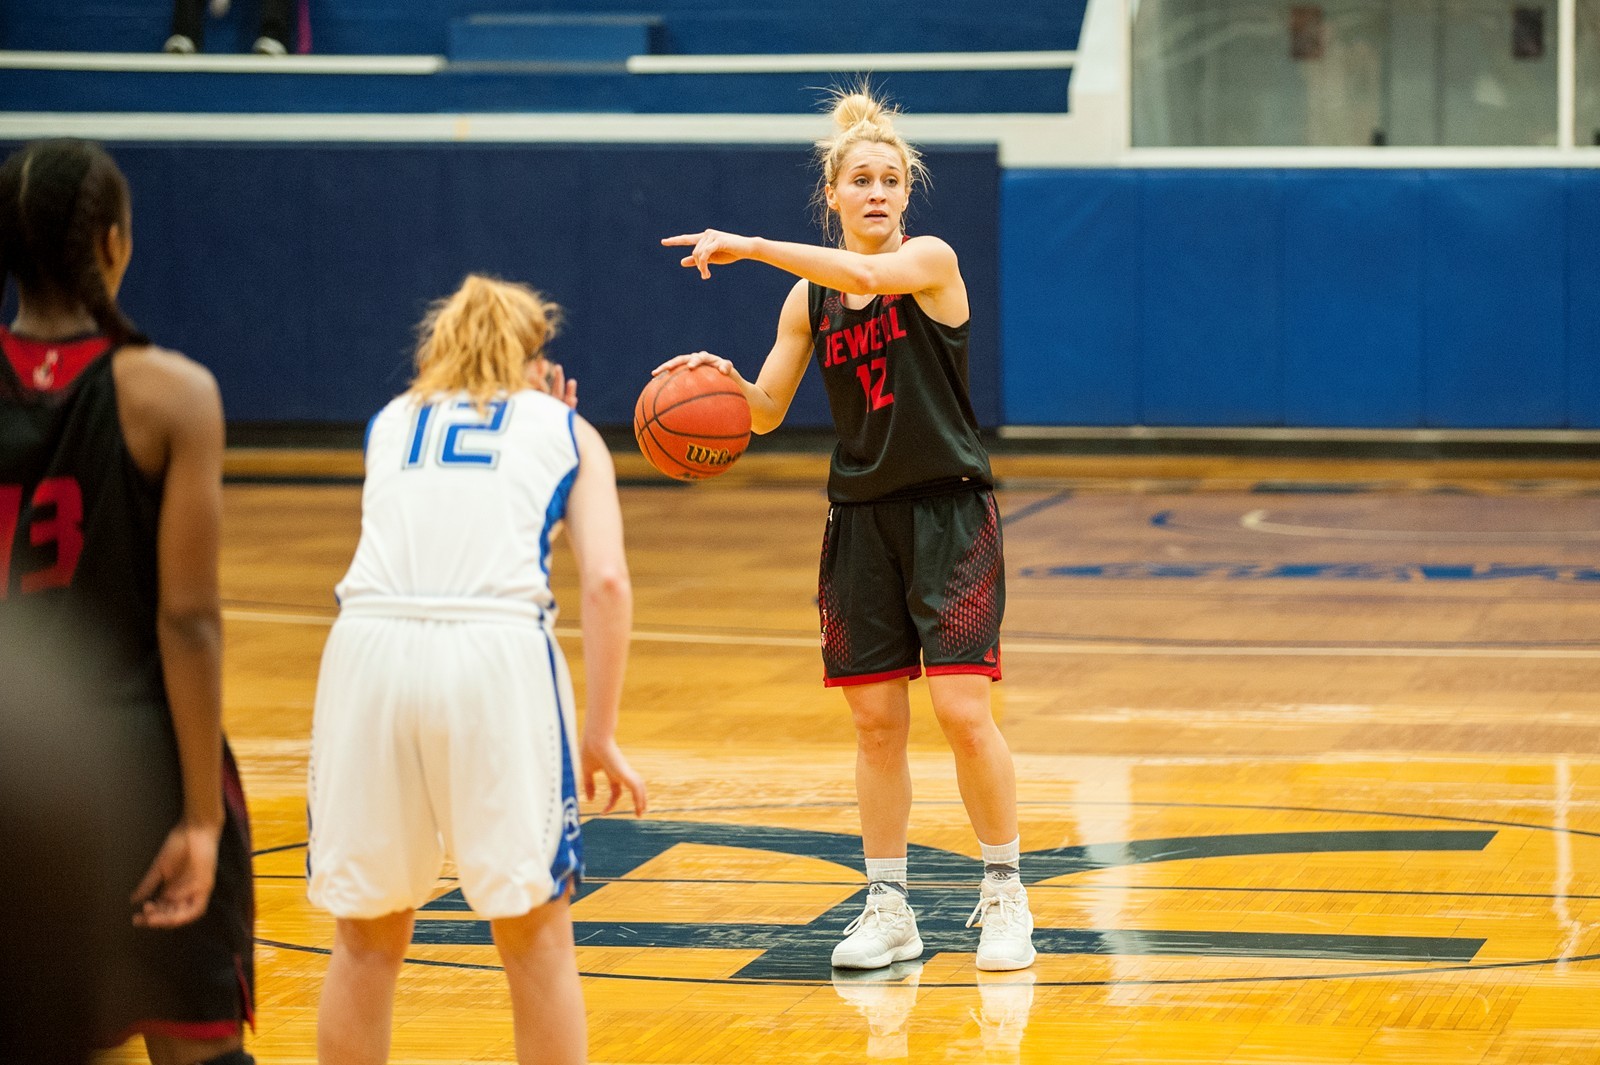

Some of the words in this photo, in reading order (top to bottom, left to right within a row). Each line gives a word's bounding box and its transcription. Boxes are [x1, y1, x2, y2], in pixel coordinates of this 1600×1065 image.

[824, 307, 907, 368] JEWELL
[856, 356, 895, 413] 12
[401, 397, 516, 470] 12
